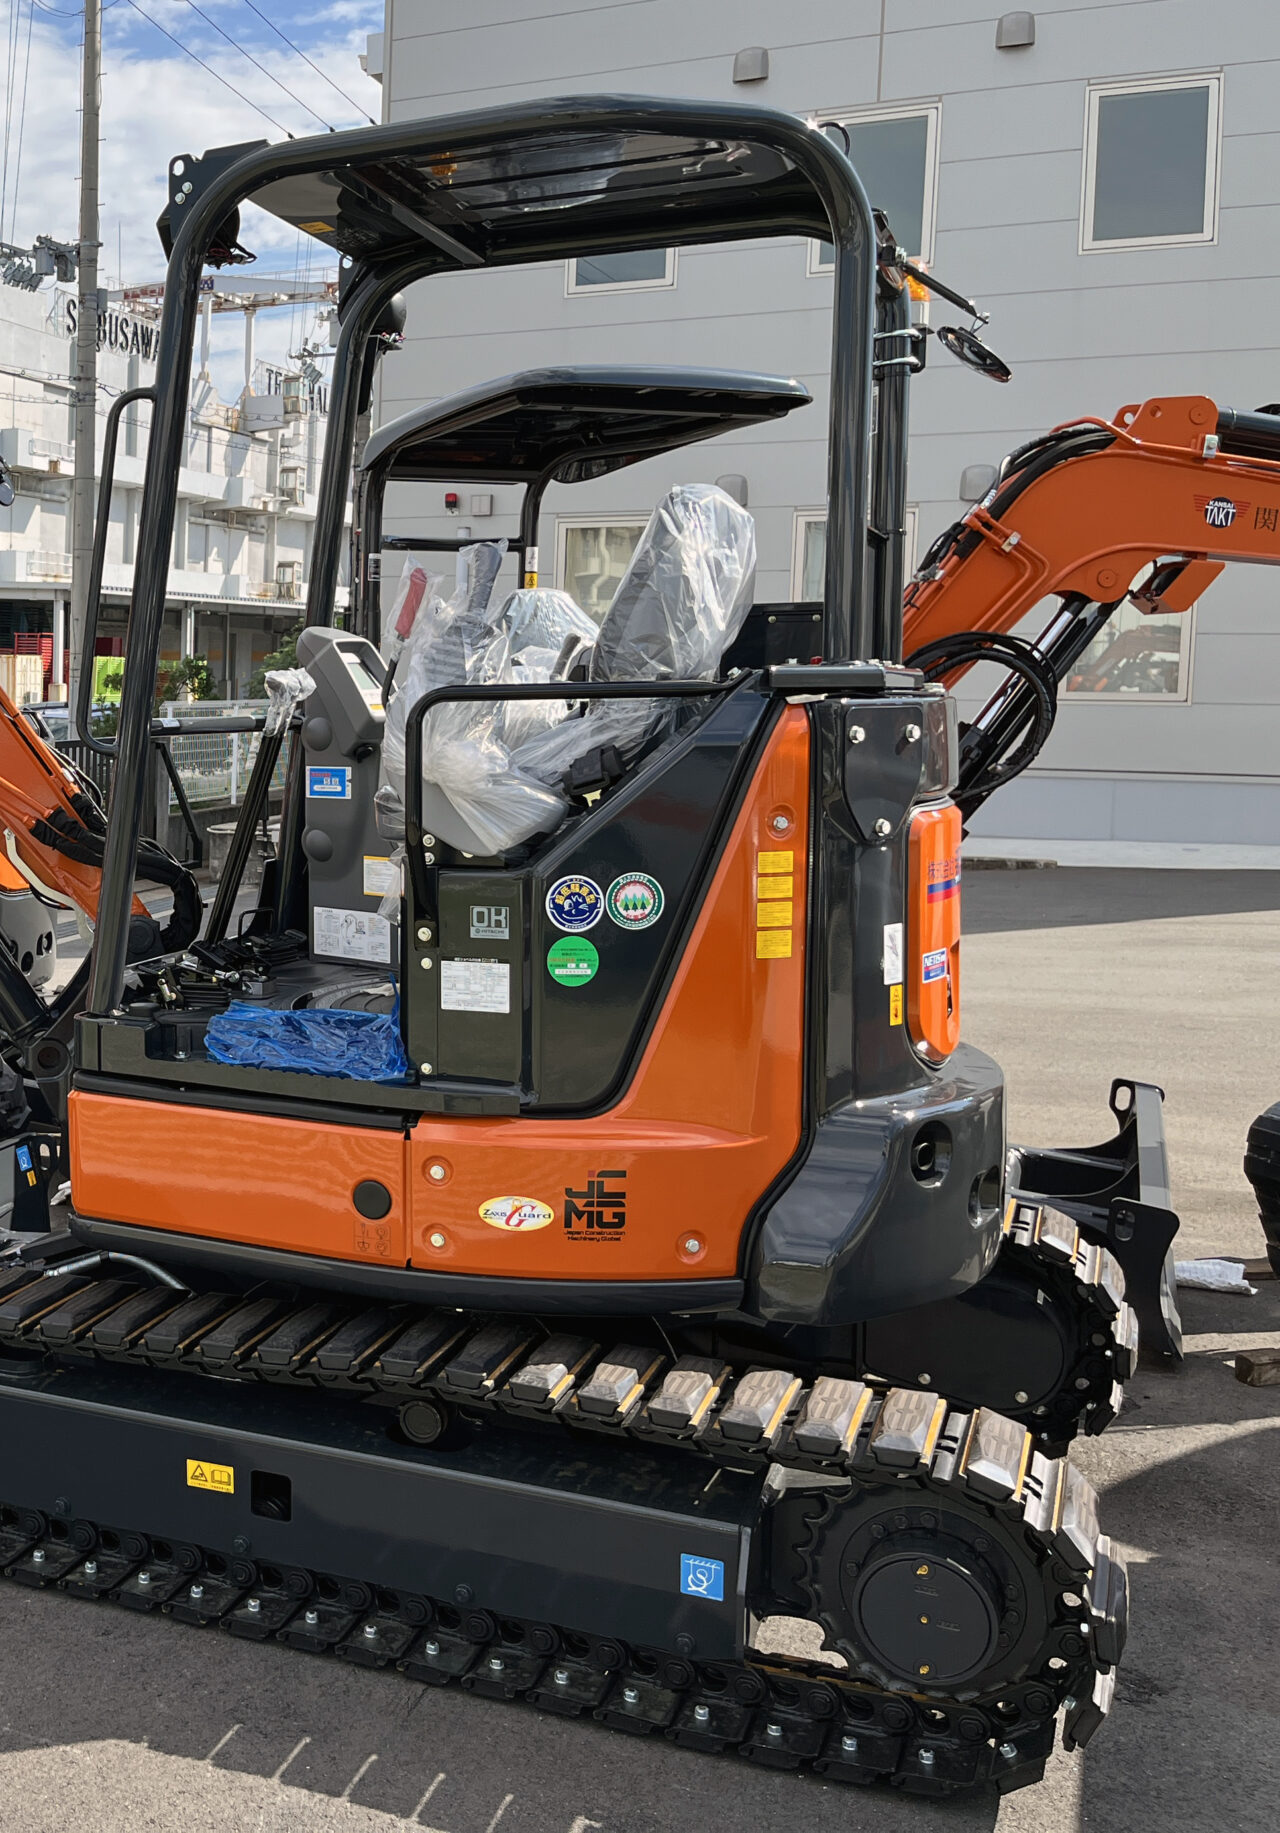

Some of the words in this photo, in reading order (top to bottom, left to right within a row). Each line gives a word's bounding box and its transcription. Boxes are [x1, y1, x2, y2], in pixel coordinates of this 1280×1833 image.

[66, 299, 161, 362] SBUSAW
[1209, 500, 1234, 508] KANSAI
[1205, 505, 1237, 527] TAKT
